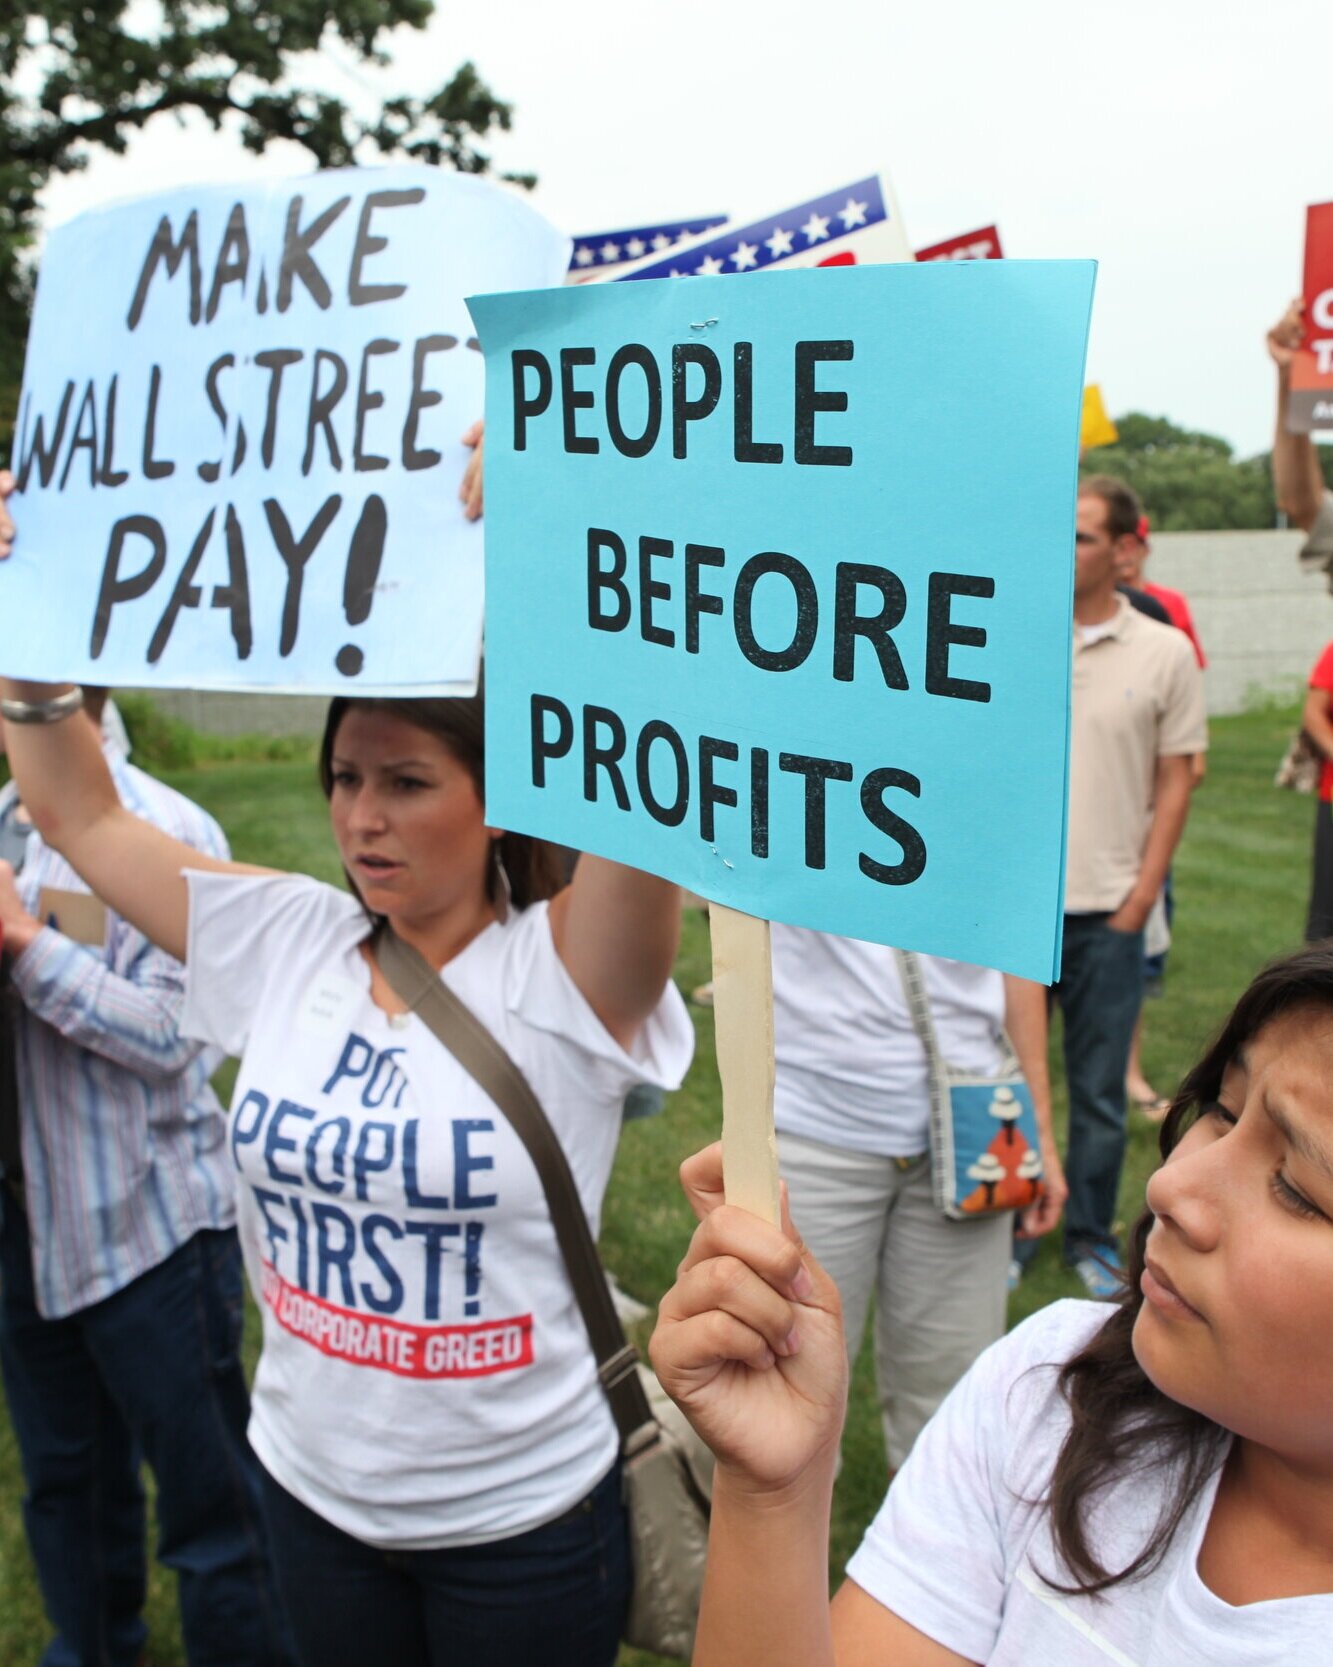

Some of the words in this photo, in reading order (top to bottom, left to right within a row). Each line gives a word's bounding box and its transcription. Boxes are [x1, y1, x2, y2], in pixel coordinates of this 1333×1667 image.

[127, 187, 426, 331] MAKE
[14, 363, 175, 494] WALL
[197, 334, 483, 483] STREE
[512, 340, 854, 466] PEOPLE
[90, 494, 388, 677] PAY!
[587, 527, 996, 703] BEFORE
[531, 694, 927, 886] PROFITS
[231, 1088, 498, 1210] PEOPLE
[252, 1184, 485, 1320] FIRST!
[279, 1284, 417, 1371] CORPORATE
[424, 1325, 522, 1374] GREED
